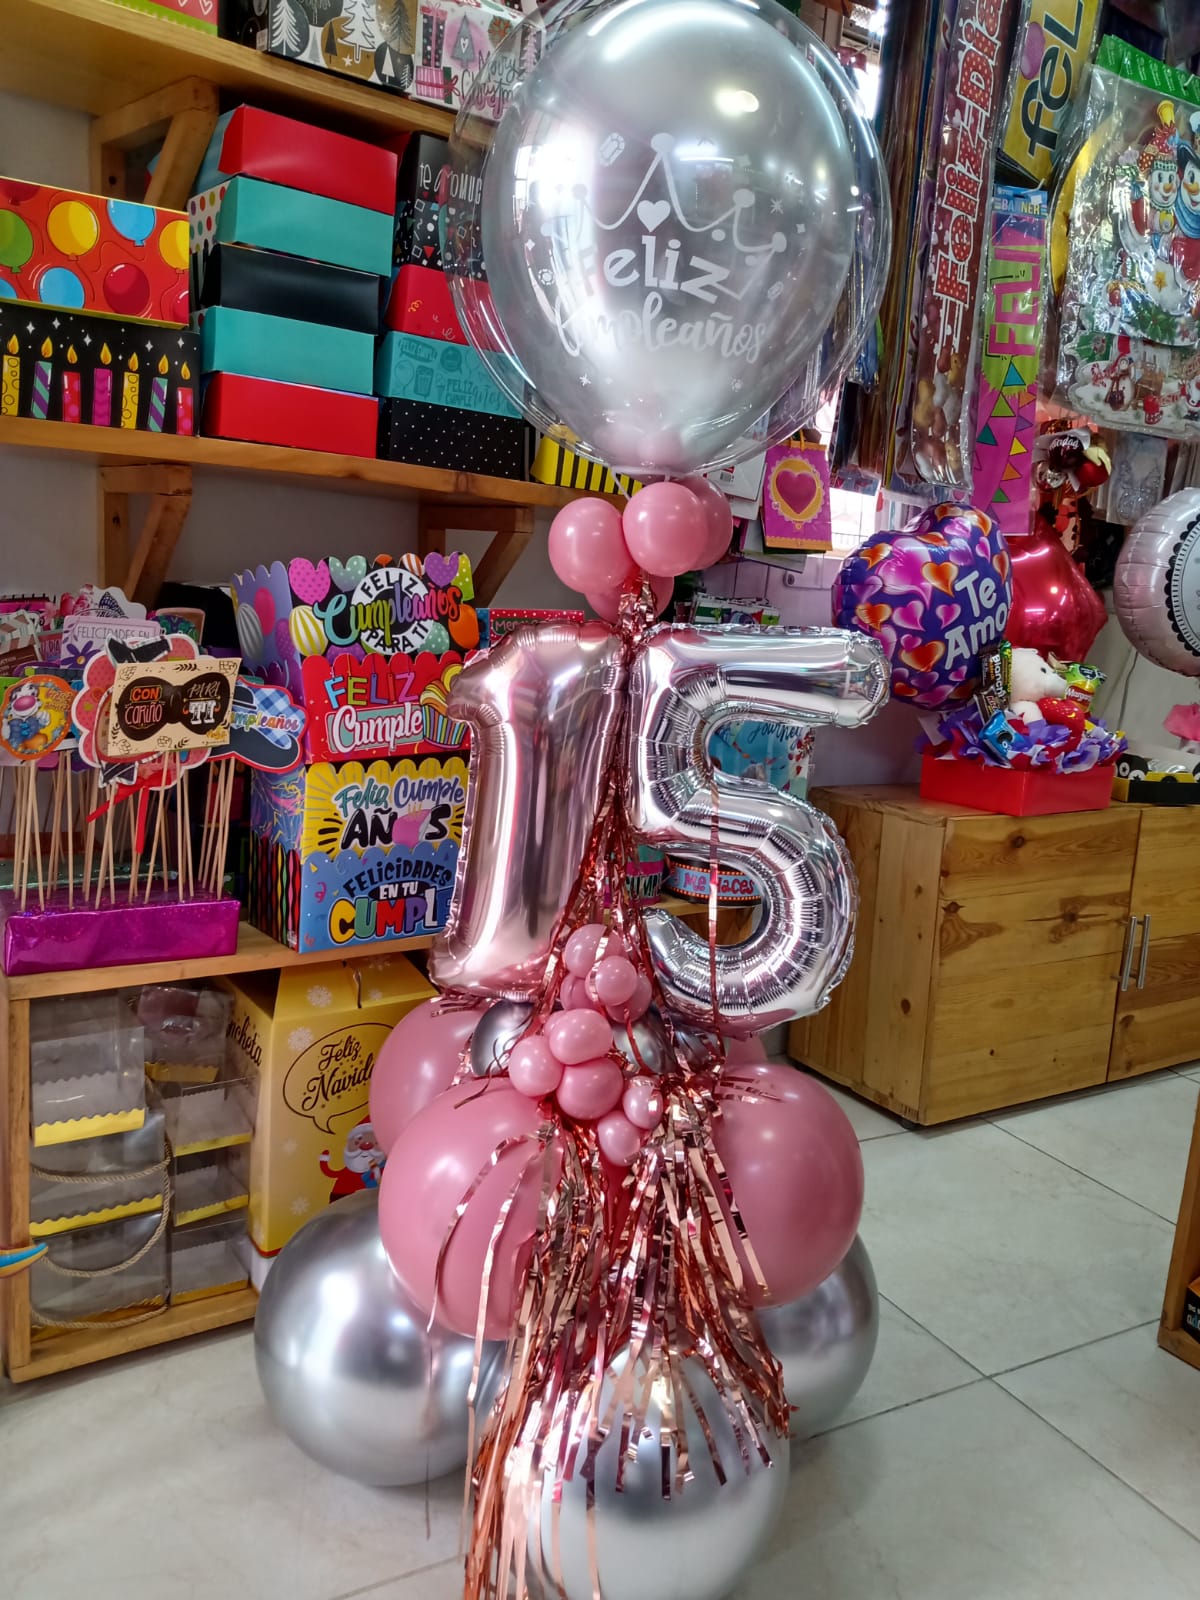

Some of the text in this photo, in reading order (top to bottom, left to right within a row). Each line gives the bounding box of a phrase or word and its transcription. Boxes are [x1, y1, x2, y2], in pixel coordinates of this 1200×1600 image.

[461, 69, 514, 105] Christm
[932, 122, 987, 310] Feliz
[1001, 198, 1040, 215] BANER
[360, 571, 418, 598] FELIZ
[954, 570, 997, 618] Te
[312, 582, 463, 647] Cumpleaños
[411, 620, 431, 641] TI
[131, 686, 161, 702] CON
[324, 671, 420, 709] FELIZ
[188, 699, 218, 725] TI
[333, 701, 424, 753] Cumple
[393, 777, 465, 809] Cumple
[429, 621, 890, 1033] 15
[379, 881, 419, 900] EN TU
[318, 1034, 362, 1071] Feliz
[301, 1053, 375, 1112] Navid
